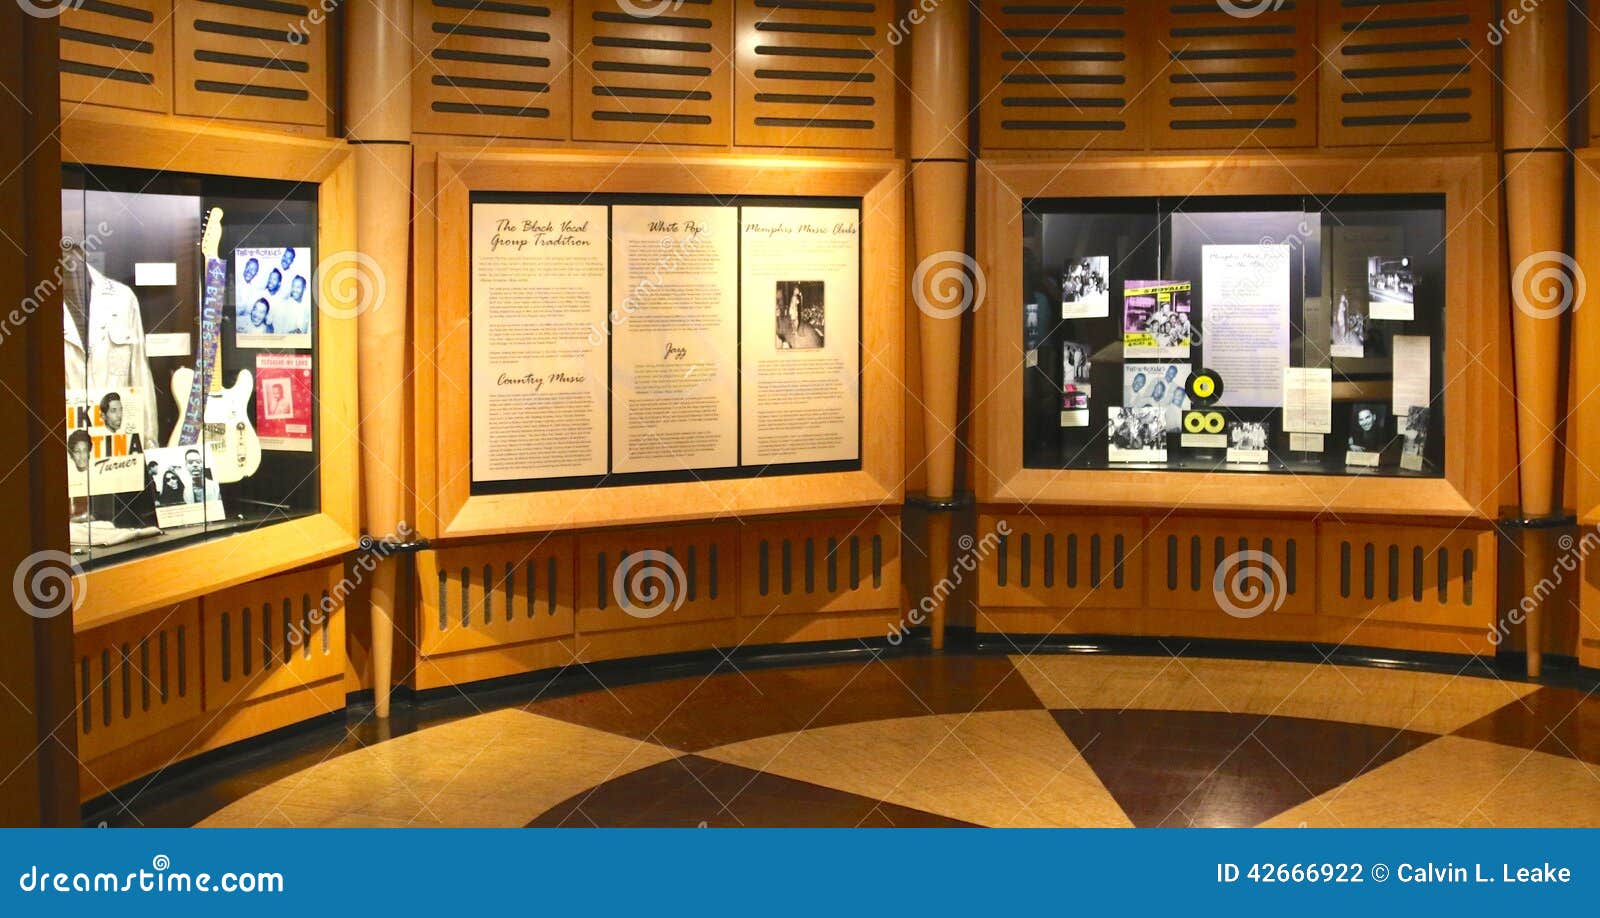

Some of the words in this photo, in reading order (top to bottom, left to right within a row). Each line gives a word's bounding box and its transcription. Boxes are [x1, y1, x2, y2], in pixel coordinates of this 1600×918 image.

[496, 218, 517, 232] The
[522, 219, 553, 232] Black
[560, 220, 591, 232] Vocal
[648, 219, 681, 233] White
[685, 220, 705, 237] Pop
[745, 223, 792, 238] Memphis
[798, 224, 827, 234] Music
[832, 223, 857, 234] Clubs
[490, 233, 528, 252] Group
[534, 232, 592, 247] Tradition
[664, 342, 687, 360] Jazz
[497, 372, 544, 392] Country
[548, 372, 586, 384] Music
[91, 433, 144, 459] TINA
[94, 458, 137, 475] Turner
